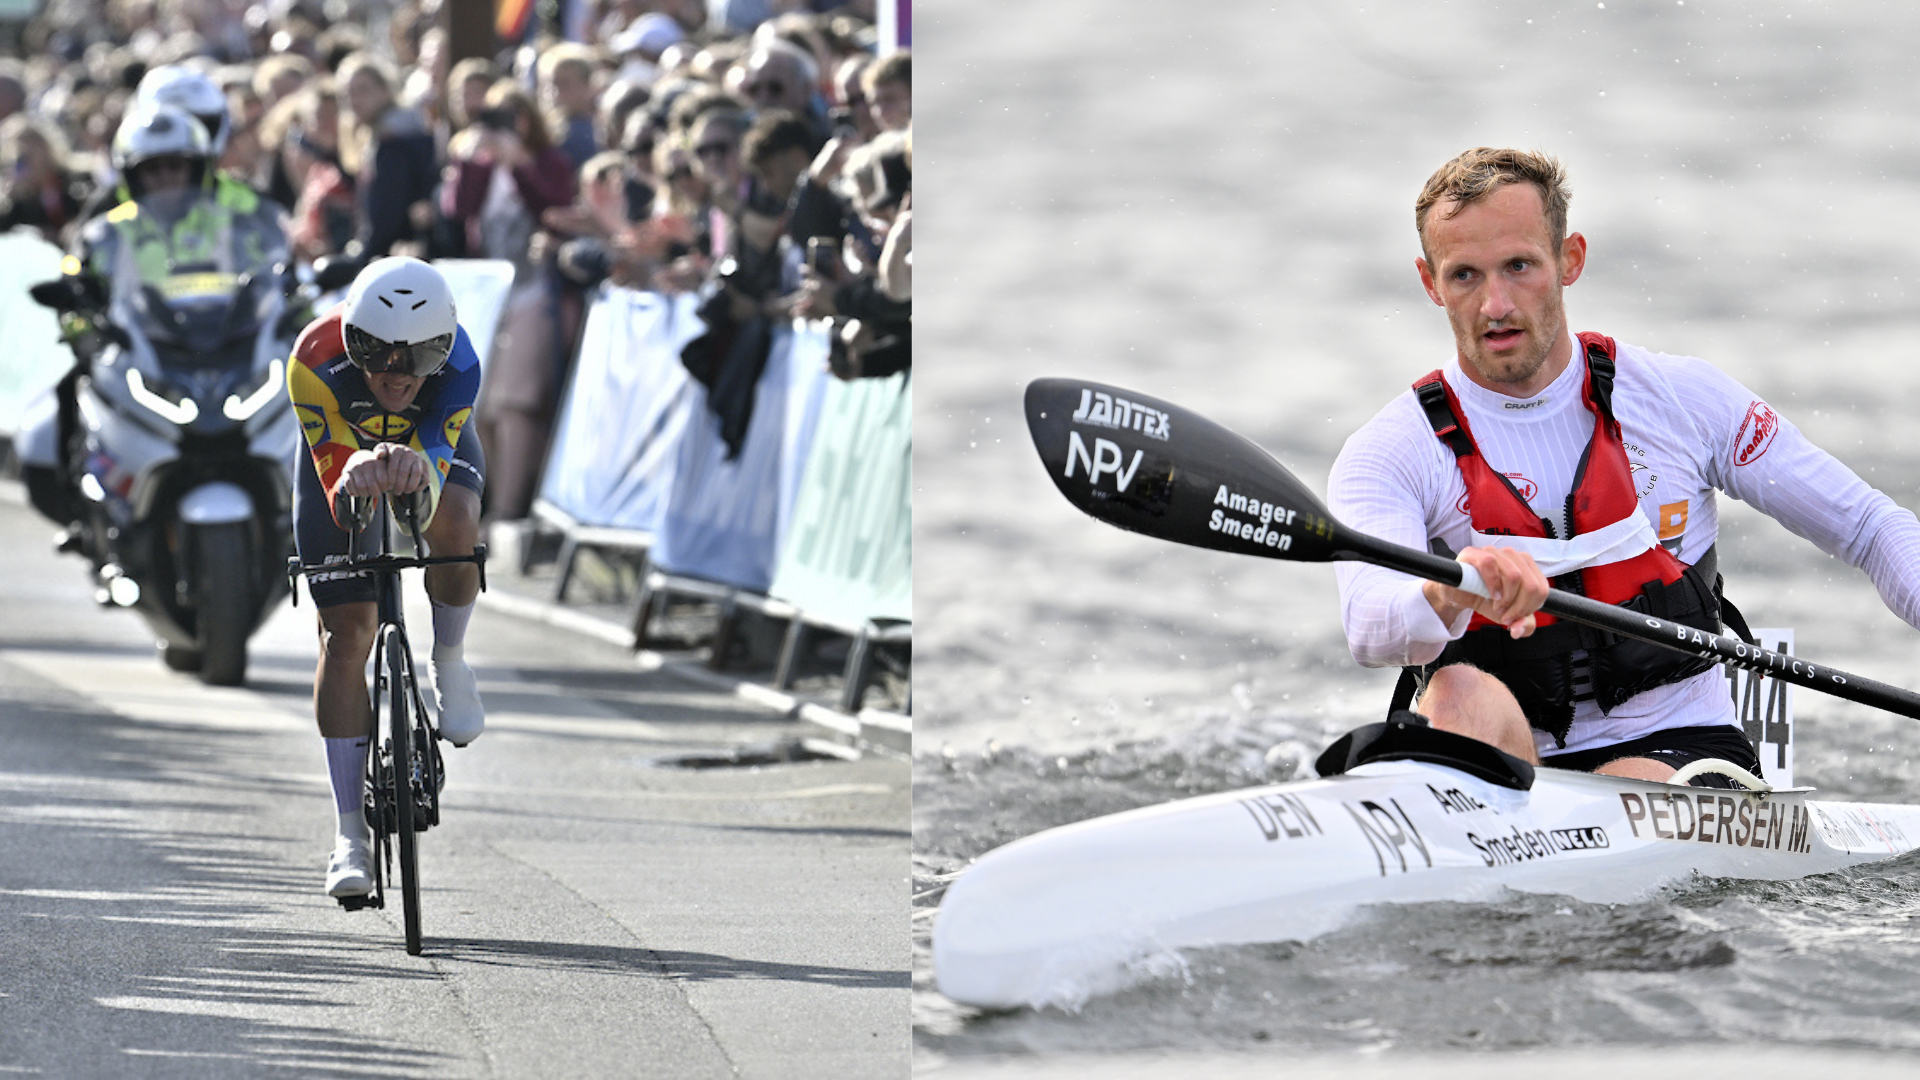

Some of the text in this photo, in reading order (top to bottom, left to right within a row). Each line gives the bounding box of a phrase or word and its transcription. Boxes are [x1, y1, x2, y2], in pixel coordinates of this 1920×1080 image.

[1504, 401, 1536, 410] CRAFT
[1064, 430, 1144, 493] NPV
[1623, 442, 1646, 457] ORG
[1213, 484, 1297, 526] Amager
[1208, 508, 1293, 551] Smeden
[1677, 626, 1718, 650] BAK
[1735, 643, 1816, 679] OPTICS
[1239, 793, 1325, 841] DEN
[1619, 792, 1786, 850] PEDERSEN
[1787, 805, 1812, 853] M.
[1466, 824, 1558, 868] Smeden
[1553, 829, 1608, 850] NELO
